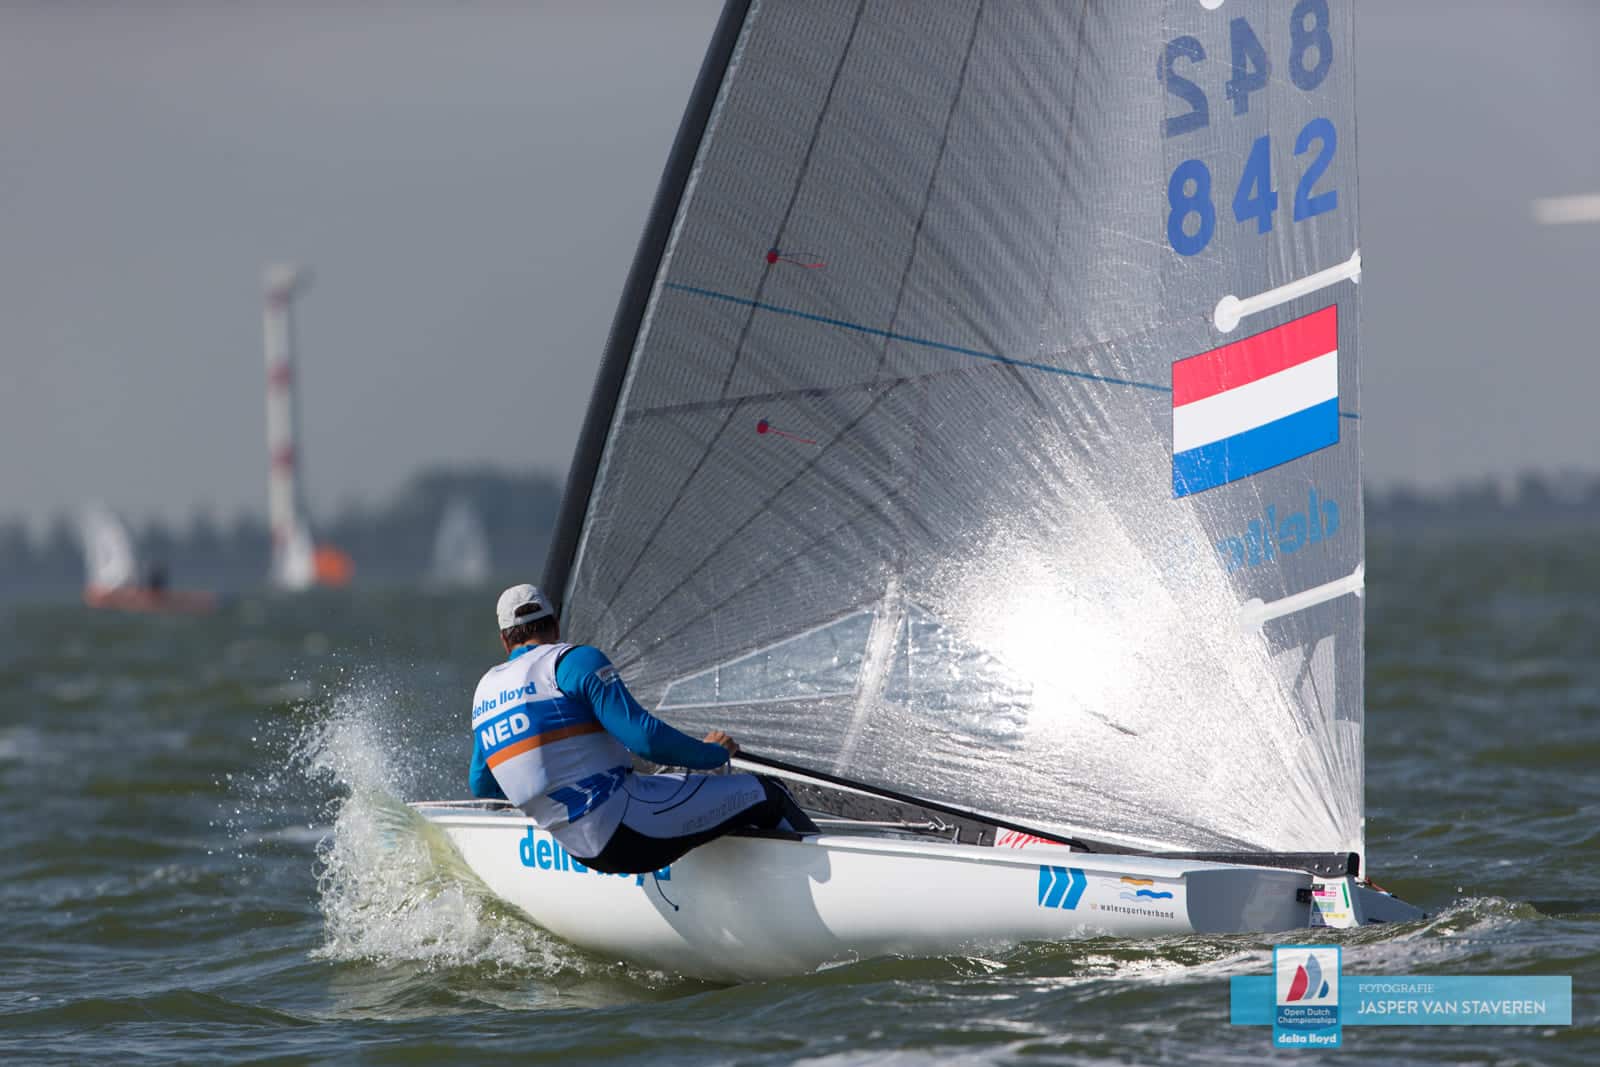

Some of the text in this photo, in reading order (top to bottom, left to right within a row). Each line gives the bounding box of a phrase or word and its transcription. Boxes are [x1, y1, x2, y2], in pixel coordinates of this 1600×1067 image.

[1167, 117, 1339, 257] 842
[472, 681, 537, 721] delta lloyd
[481, 712, 531, 751] NED
